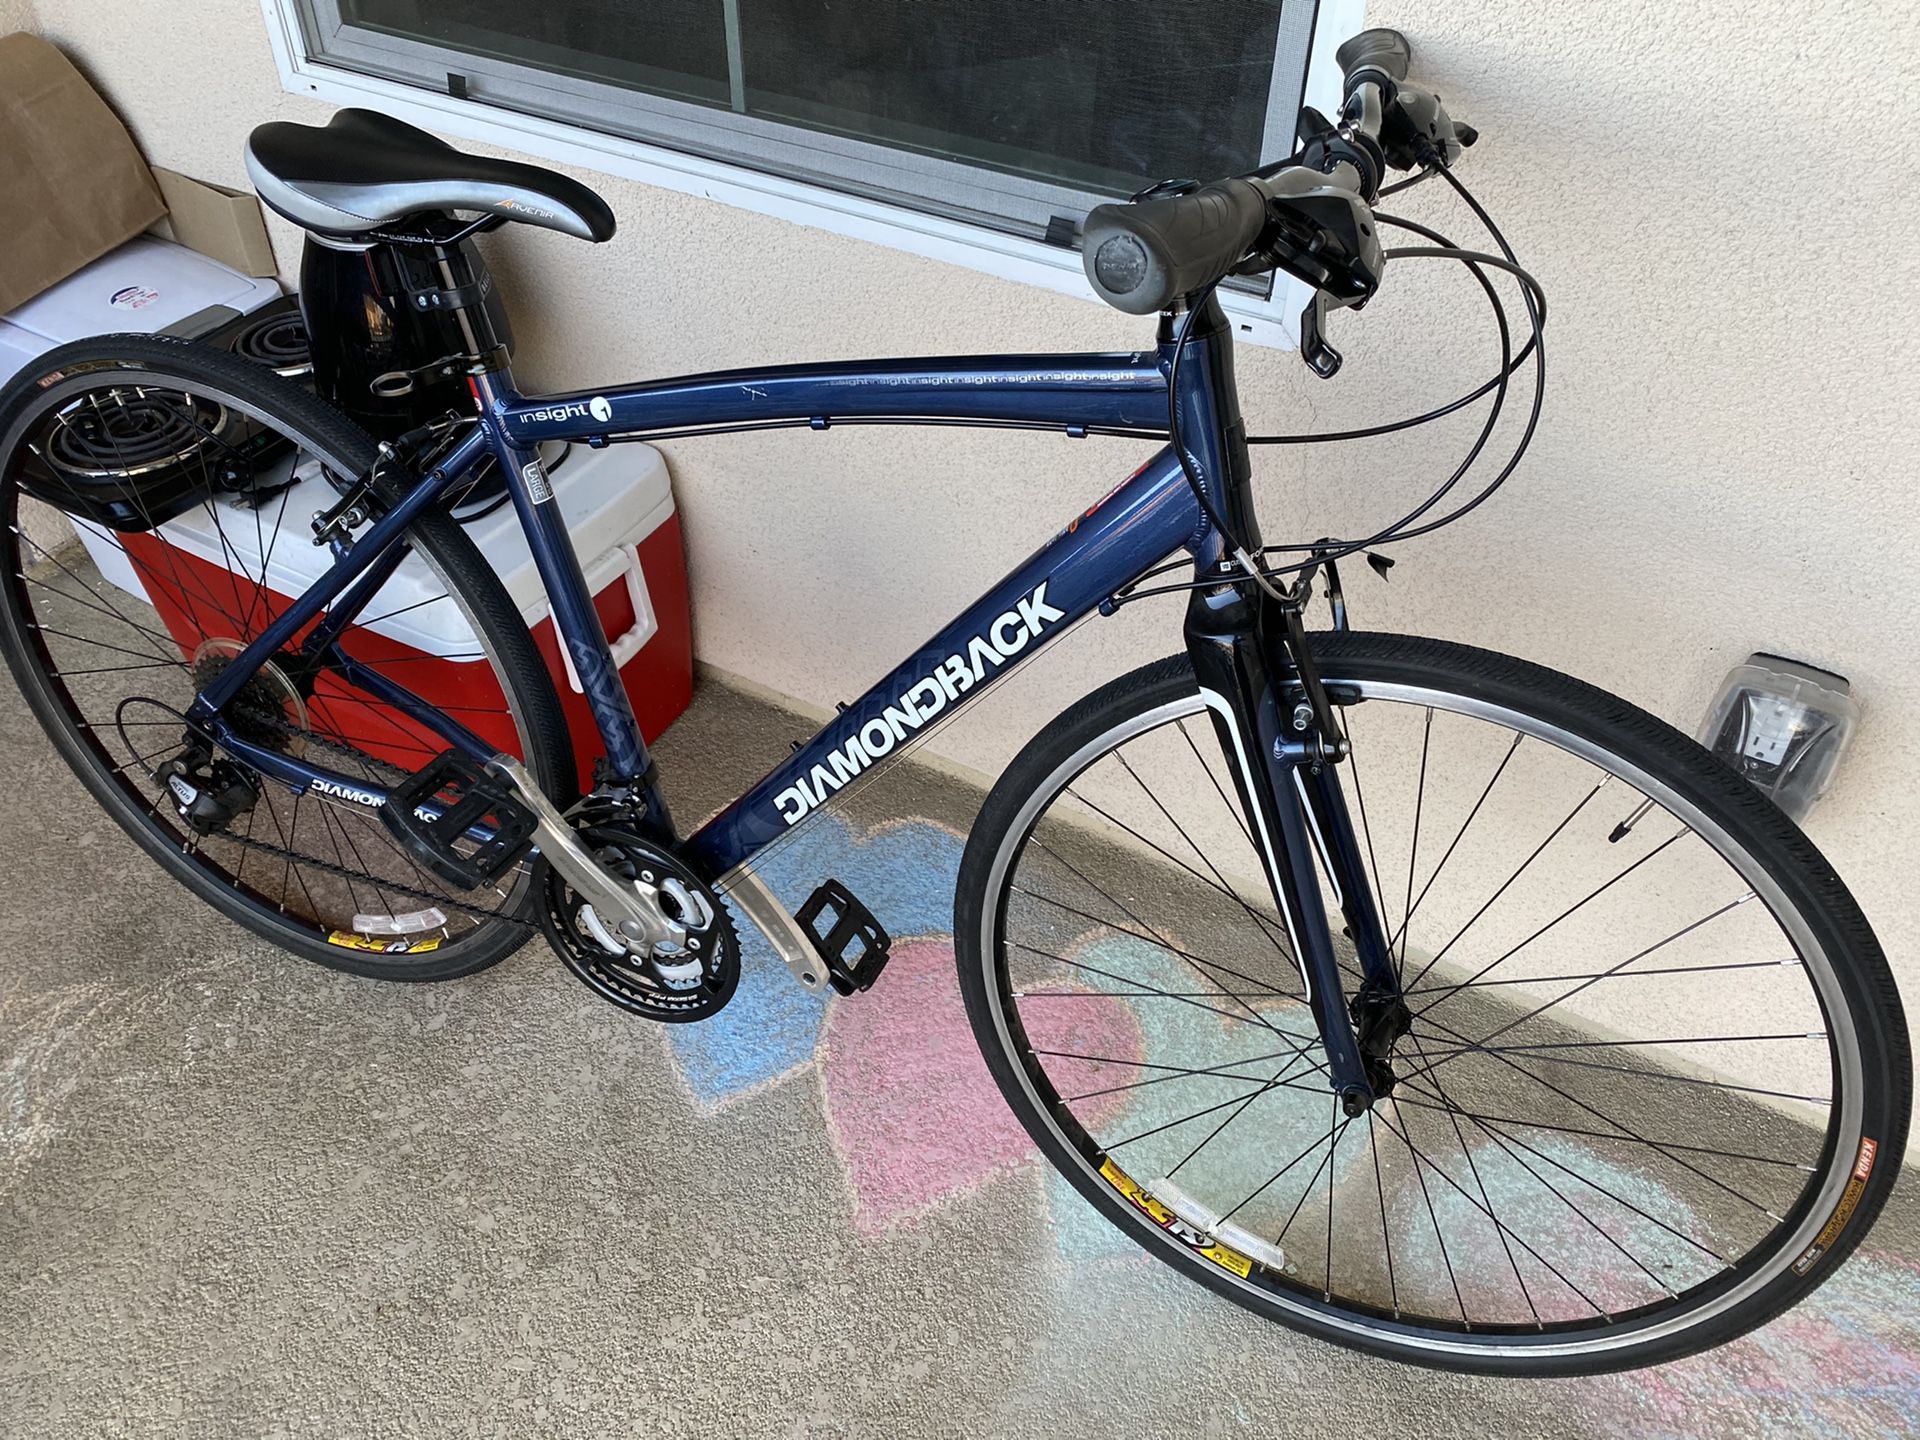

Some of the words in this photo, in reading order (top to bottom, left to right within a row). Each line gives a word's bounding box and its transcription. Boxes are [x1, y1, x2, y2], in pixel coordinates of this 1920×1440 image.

[520, 404, 589, 423] insight
[527, 467, 545, 499] LARGE
[773, 581, 1066, 826] DIAMONDBACK
[171, 781, 191, 800] ALTUS
[1857, 1141, 1875, 1180] KENDA
